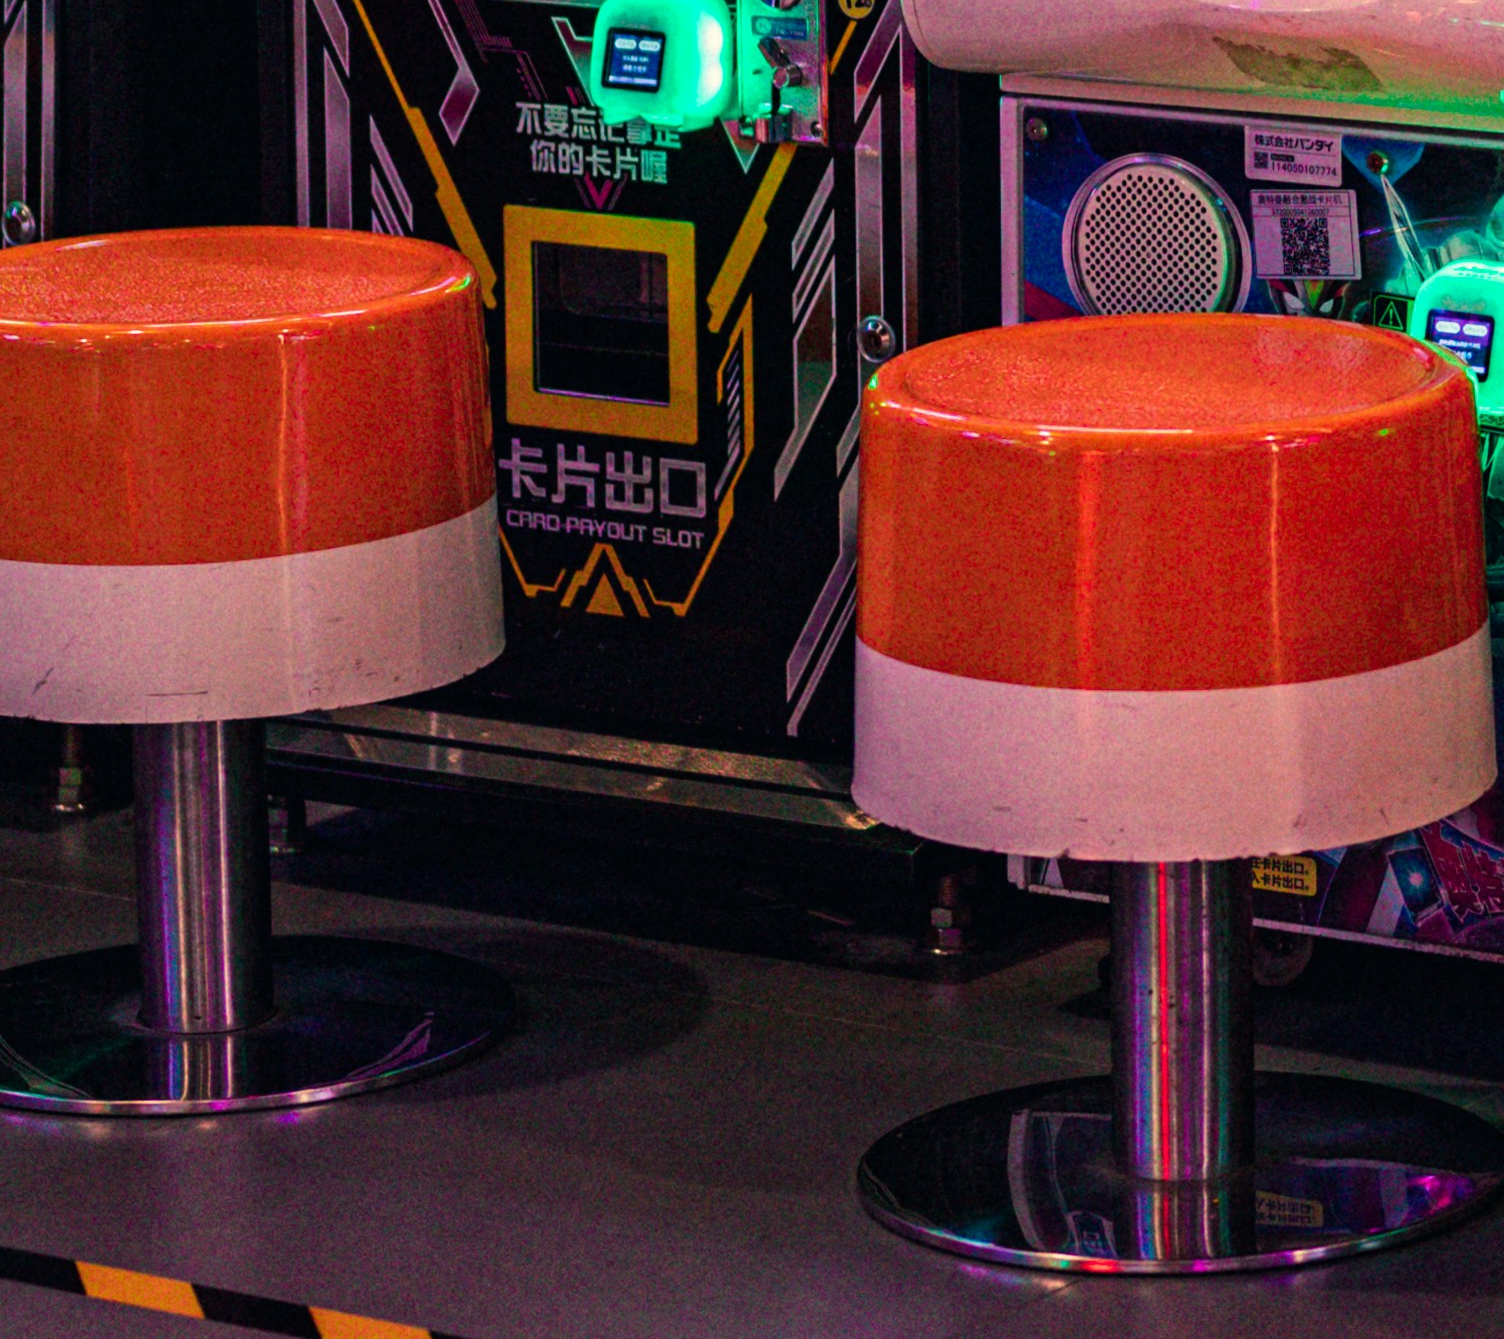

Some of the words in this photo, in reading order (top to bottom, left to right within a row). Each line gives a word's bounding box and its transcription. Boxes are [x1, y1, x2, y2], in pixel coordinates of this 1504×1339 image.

[1253, 133, 1335, 153] 株式会社バンダイ
[1270, 161, 1338, 177] 114050107774
[497, 435, 707, 520] 卡片出口
[505, 508, 561, 533] CARD
[564, 515, 648, 543] PAYOUT
[651, 525, 705, 550] SLOT
